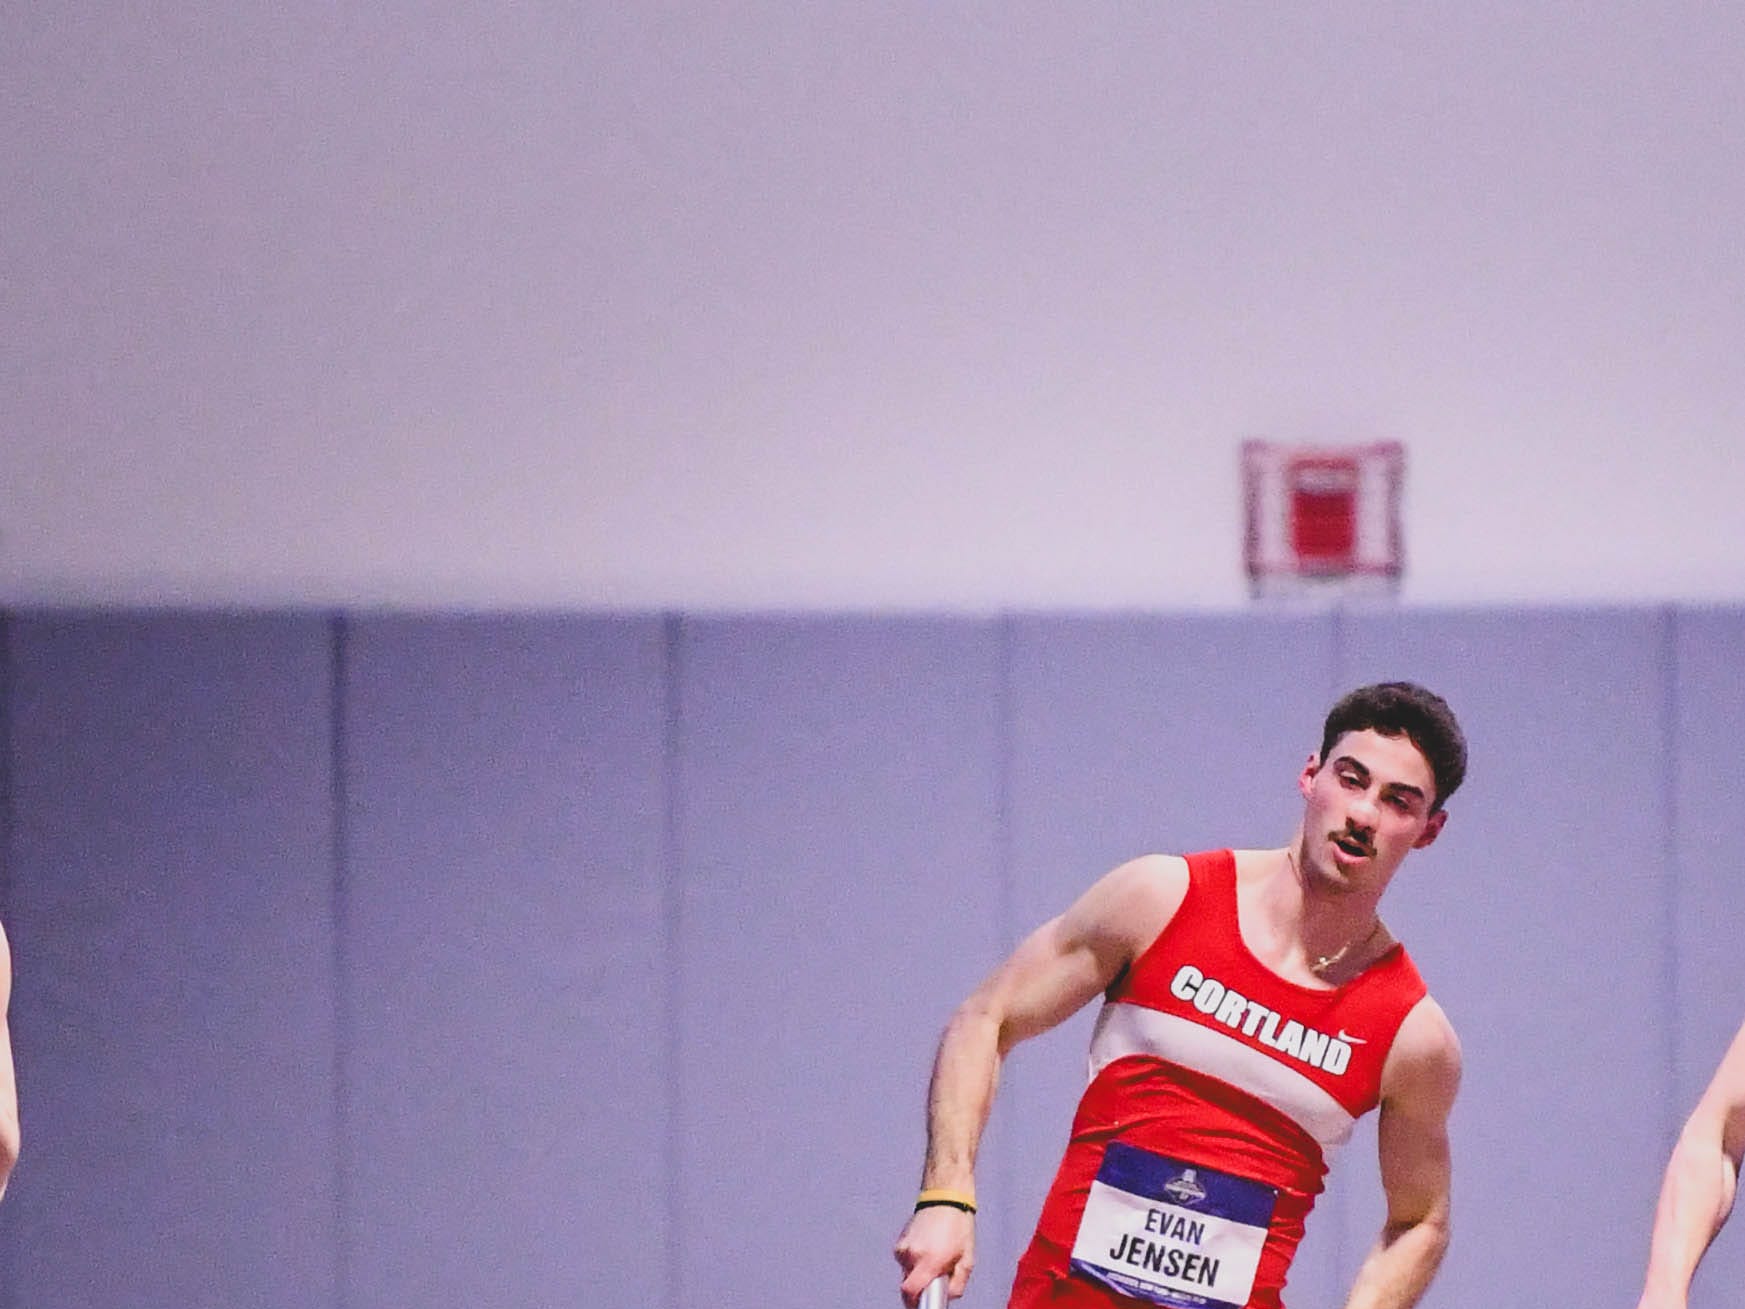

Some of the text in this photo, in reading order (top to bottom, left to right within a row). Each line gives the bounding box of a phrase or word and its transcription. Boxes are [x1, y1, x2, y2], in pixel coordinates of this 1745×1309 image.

[1170, 964, 1352, 1076] CORTLAND
[1144, 1208, 1205, 1246] EVAN
[1109, 1233, 1220, 1288] JENSEN
